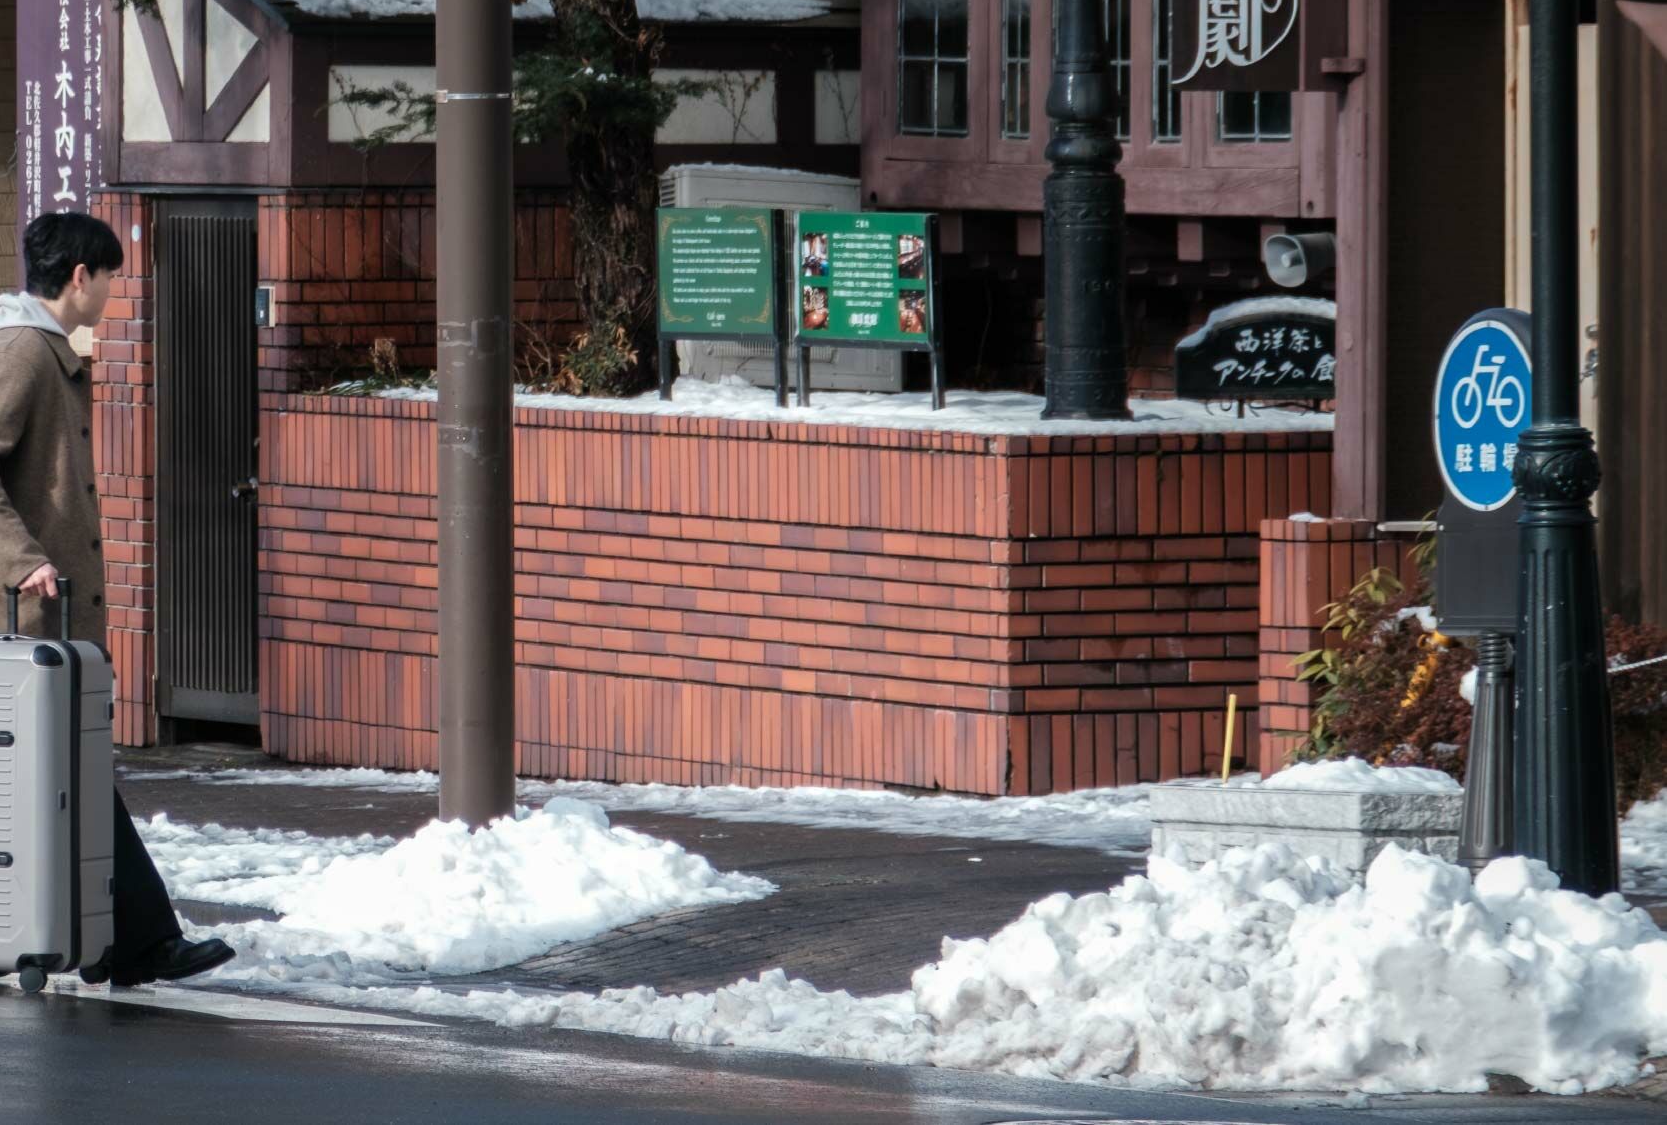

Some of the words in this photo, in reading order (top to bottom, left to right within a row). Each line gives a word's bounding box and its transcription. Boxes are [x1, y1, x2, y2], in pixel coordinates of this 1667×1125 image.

[25, 80, 33, 125] TEL
[54, 60, 77, 214] 木内工
